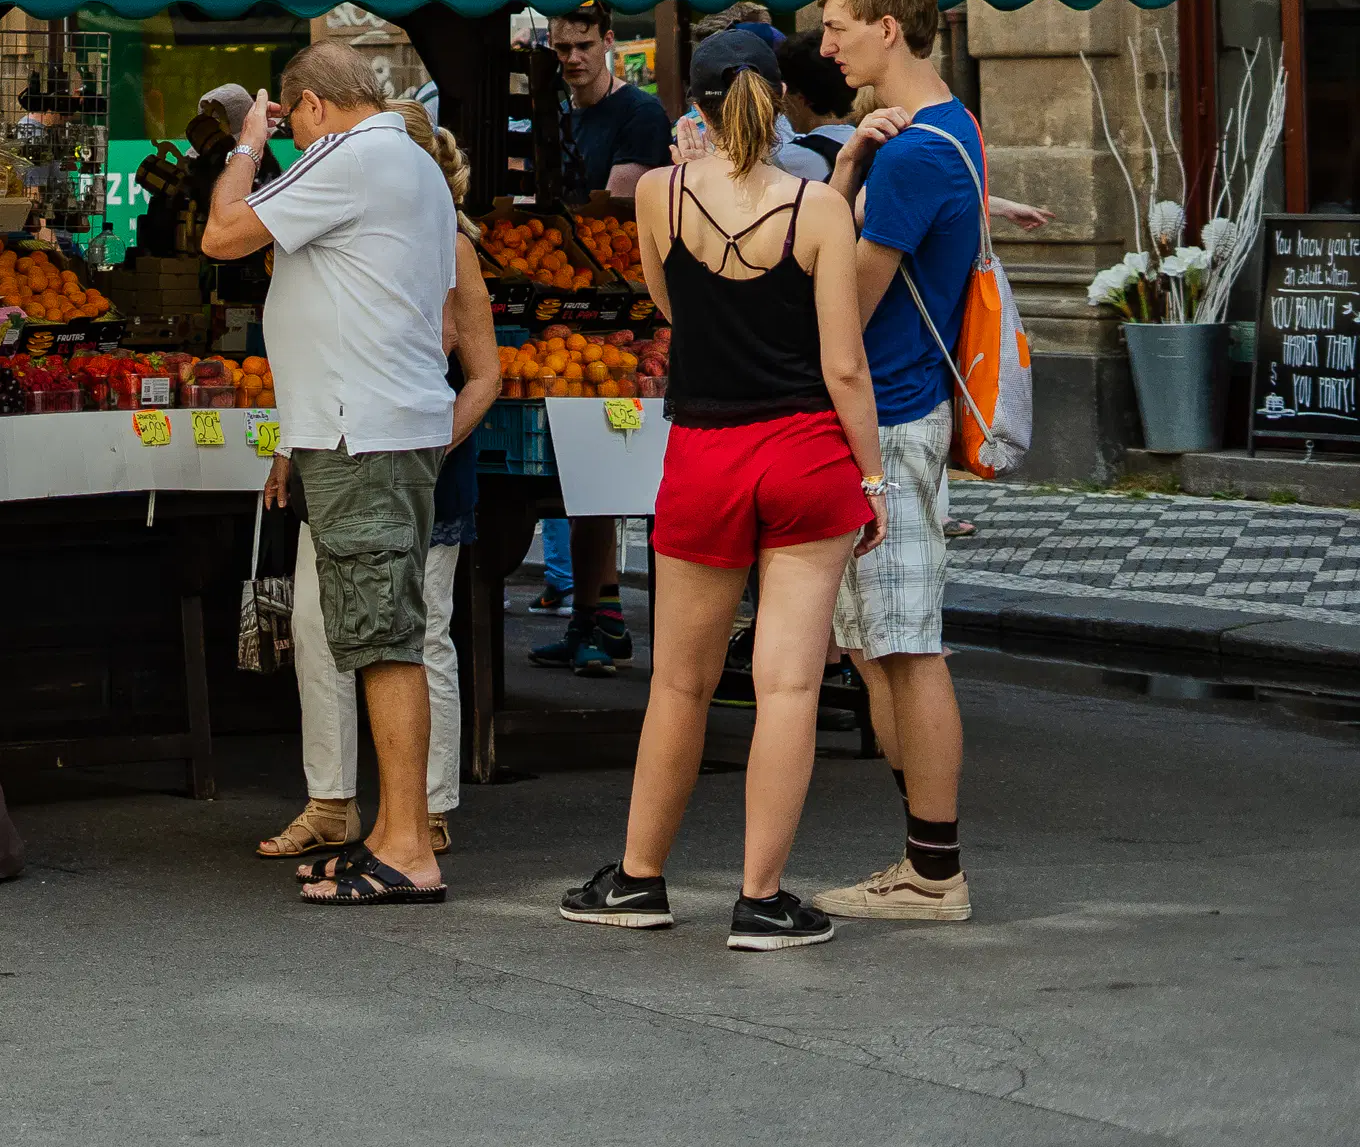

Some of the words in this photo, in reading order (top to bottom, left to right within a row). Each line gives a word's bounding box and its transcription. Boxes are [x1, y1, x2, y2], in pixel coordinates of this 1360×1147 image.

[1275, 230, 1292, 256] You
[1297, 229, 1324, 258] know
[1327, 232, 1360, 266] you're
[1283, 267, 1296, 286] an
[1297, 264, 1324, 285] adult
[562, 302, 590, 310] FRUTAS
[1271, 296, 1294, 330] YOU
[1294, 296, 1335, 331] BRUNCH
[56, 332, 86, 342] FRUTAS
[1282, 334, 1319, 367] HARDER
[1325, 335, 1357, 371] THAN
[1292, 373, 1312, 412] YOU
[1318, 376, 1356, 413] PARTY!
